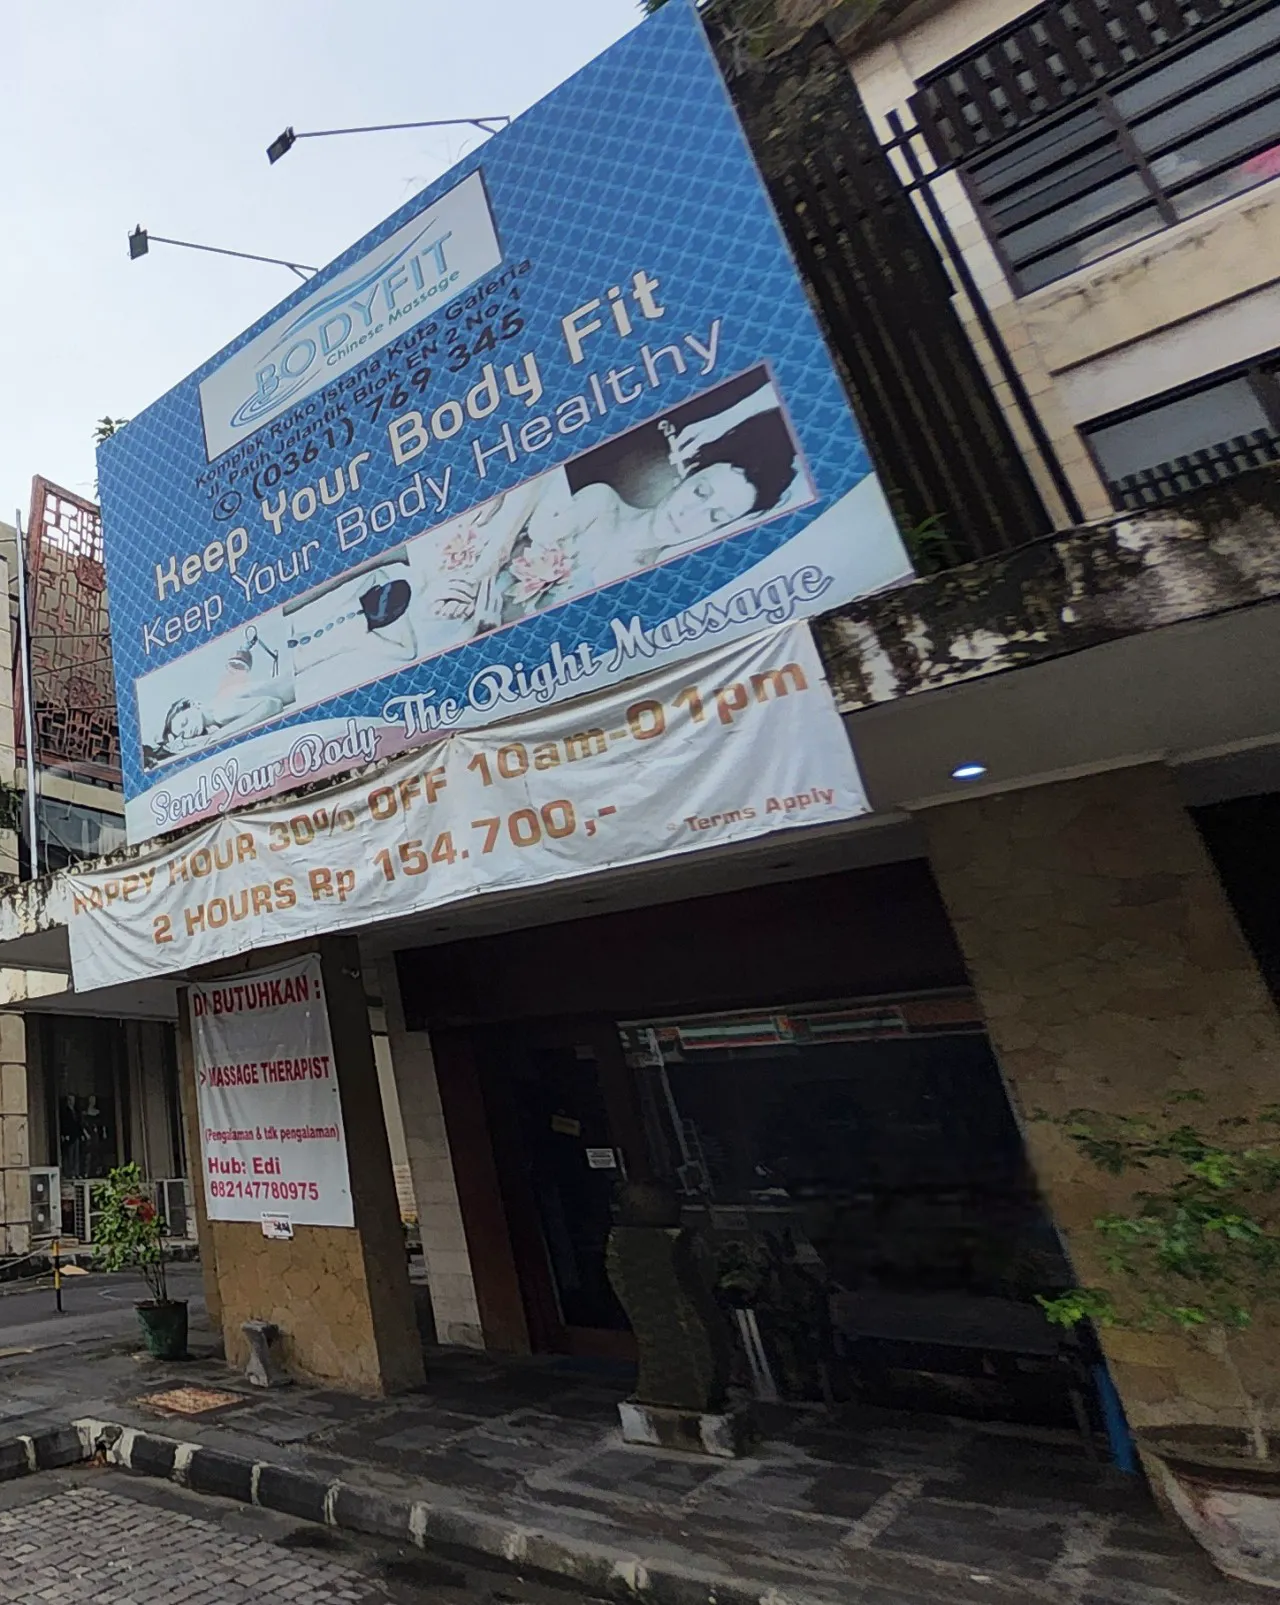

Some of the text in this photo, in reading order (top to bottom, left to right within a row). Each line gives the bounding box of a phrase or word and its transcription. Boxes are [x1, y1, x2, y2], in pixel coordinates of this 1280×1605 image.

[254, 231, 452, 402] BODYFIT
[271, 403, 316, 437] Ruko
[322, 361, 381, 404] Istana
[387, 321, 438, 359] Kuta
[445, 258, 532, 321] Galeria
[326, 270, 461, 367] Chinese Massage
[154, 269, 665, 602] Keep Your Body Fit
[229, 450, 270, 485] Patih
[276, 403, 347, 455] Jelantik
[353, 368, 399, 403] Blok
[407, 340, 438, 370] EN
[446, 327, 459, 346] 2
[252, 308, 525, 500] (0361) 769 345
[142, 317, 722, 656] Keep Your Body Healthy
[150, 564, 835, 827] Send Your Body The Right Massage
[72, 866, 157, 916] HAPPY
[170, 831, 257, 886] HOUR
[268, 802, 356, 852] 30%
[367, 765, 448, 822] OFF
[152, 798, 618, 945] 2 HOURS Rp 154.700,-
[683, 787, 835, 832] Terms Apply
[193, 992, 208, 1017] DI
[212, 974, 310, 1016] BUTUHKAN
[208, 1056, 330, 1088] MASSAGE THERAPIST
[280, 1122, 340, 1144] pengalaman)
[208, 1156, 282, 1175] Hub: Edi
